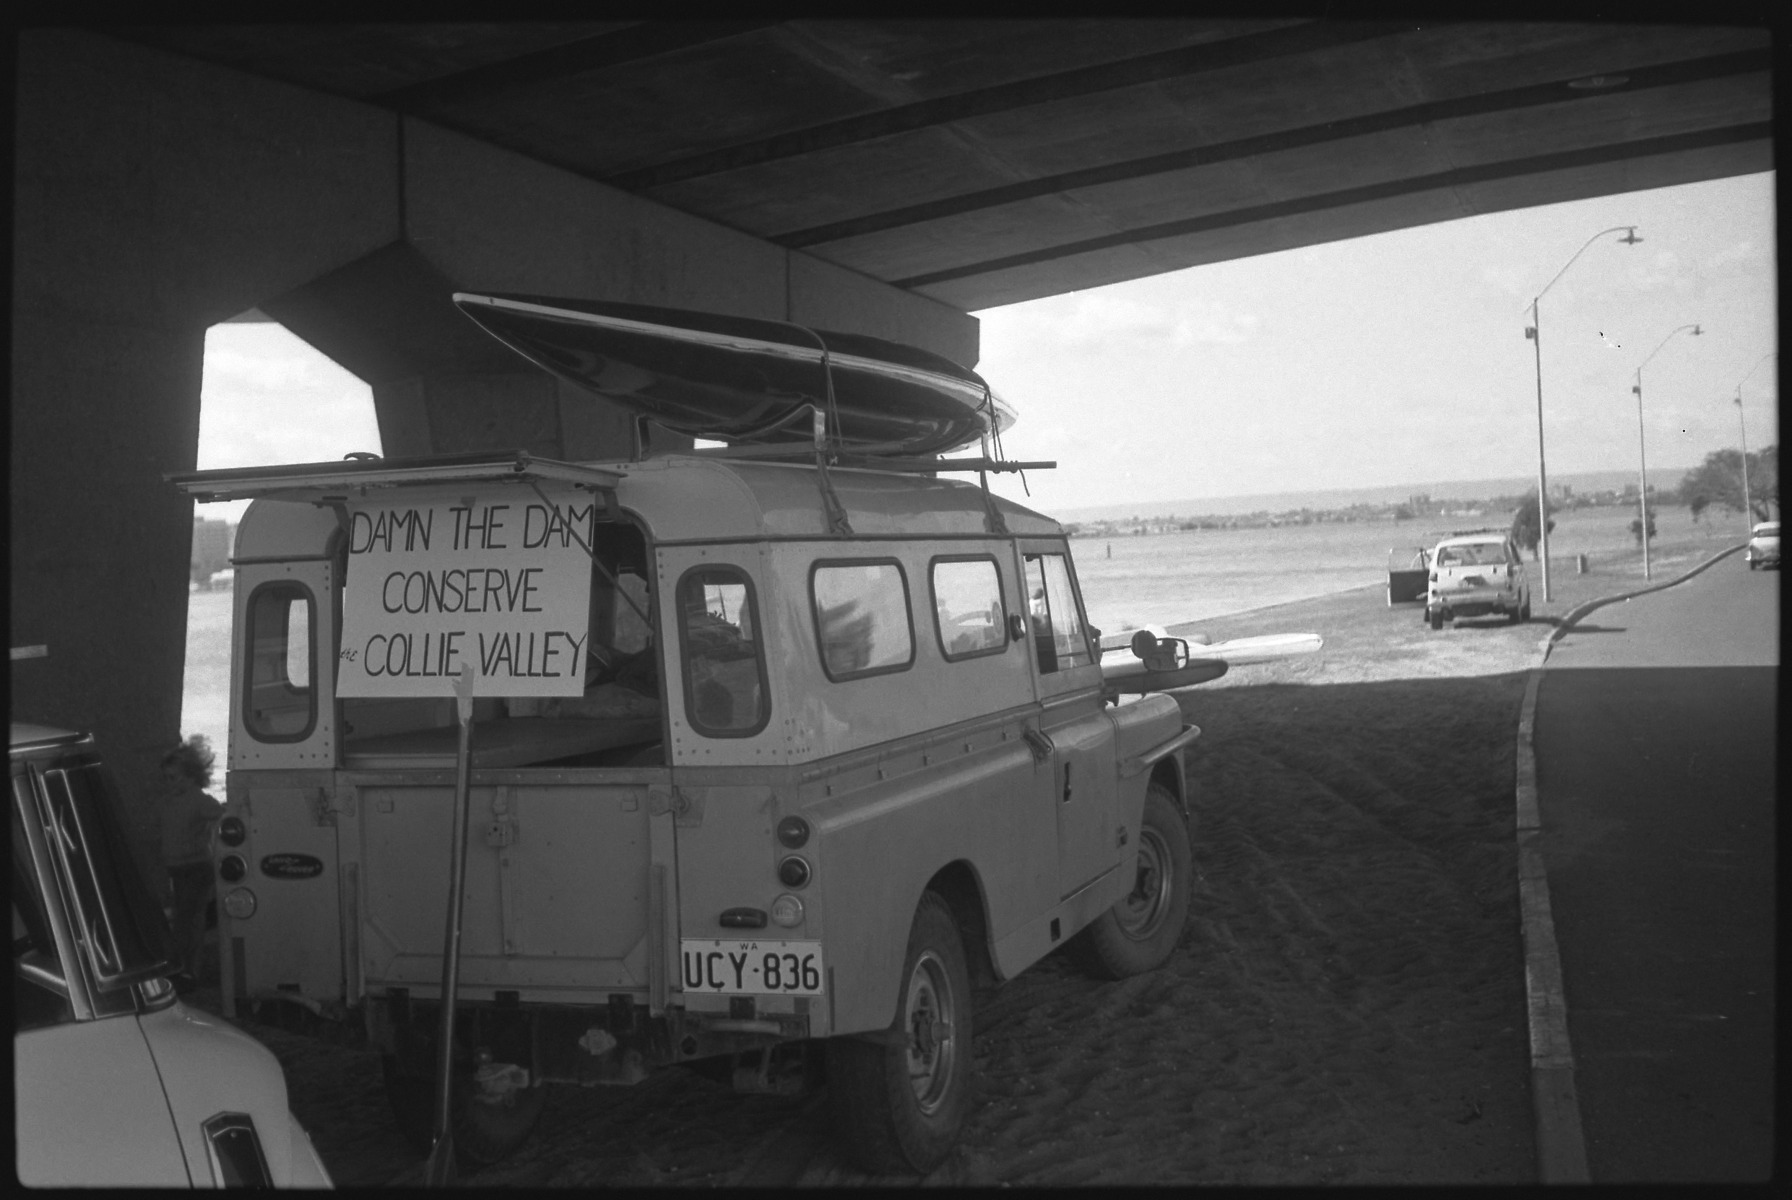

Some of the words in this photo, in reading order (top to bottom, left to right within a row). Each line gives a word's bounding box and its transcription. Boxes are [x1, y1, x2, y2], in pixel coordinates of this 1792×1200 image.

[350, 508, 433, 554] DAMN
[449, 505, 510, 550] THE
[523, 504, 594, 549] DAM
[383, 568, 543, 614] CONSERVE
[364, 631, 465, 677] COLLIE
[479, 632, 587, 677] VALLEY
